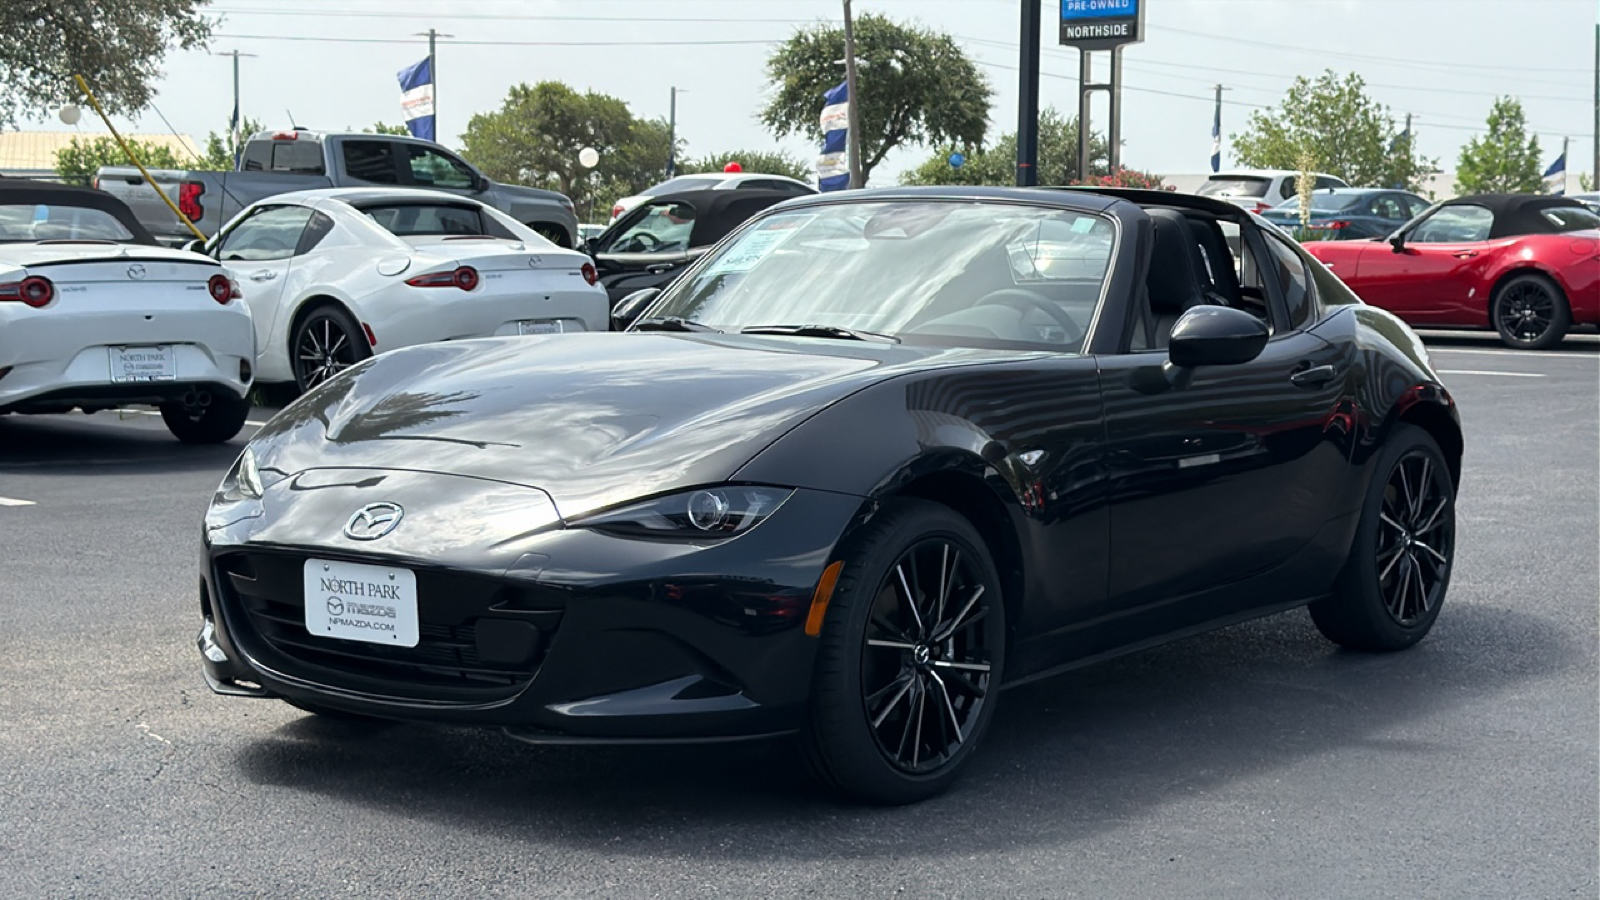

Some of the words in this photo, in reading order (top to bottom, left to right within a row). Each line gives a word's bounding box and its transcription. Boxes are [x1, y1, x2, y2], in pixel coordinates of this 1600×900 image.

[1068, 0, 1129, 11] PRE-OWNED
[1067, 24, 1128, 38] NORTHSIDE
[320, 577, 365, 596] NORTH
[367, 582, 401, 601] PARK
[329, 617, 395, 631] NPMAZDA.COM
